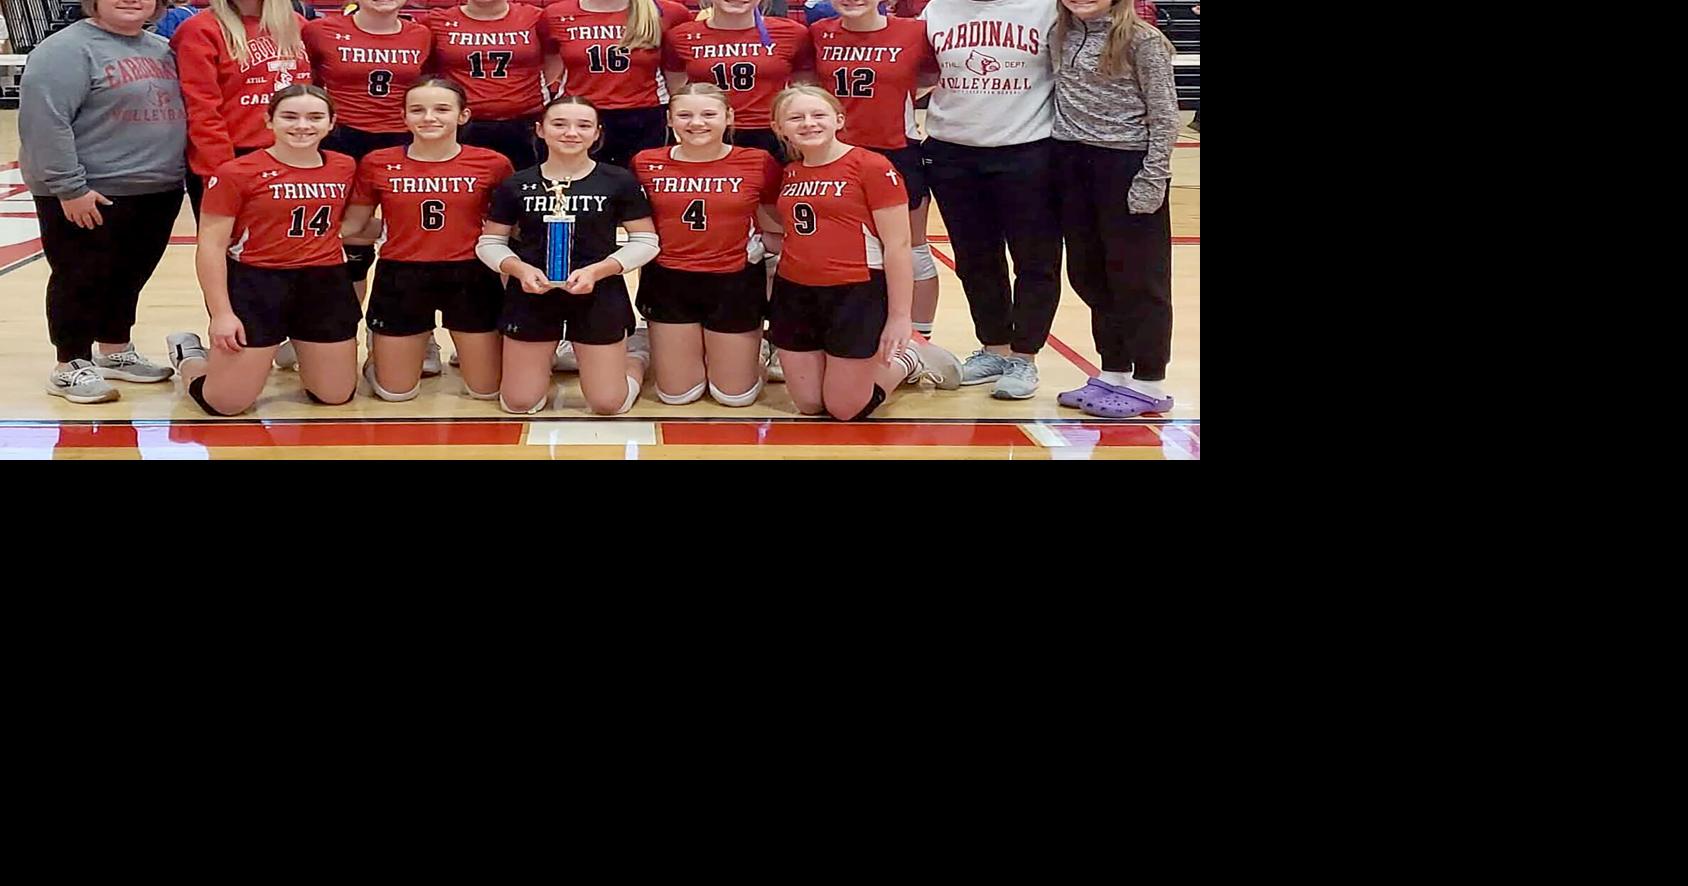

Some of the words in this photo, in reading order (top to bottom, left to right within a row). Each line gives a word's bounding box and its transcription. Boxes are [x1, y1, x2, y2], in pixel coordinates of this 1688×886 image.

[448, 31, 530, 46] TRINITY
[566, 25, 626, 41] TRINI
[931, 20, 1040, 55] CARDINALS
[337, 46, 421, 65] TRINITY
[586, 45, 631, 74] 16
[691, 43, 776, 59] TRINITY
[821, 46, 902, 63] TRINITY
[467, 51, 513, 79] 17
[367, 69, 393, 97] 8
[711, 62, 756, 92] 18
[834, 67, 876, 98] 12
[940, 77, 1033, 91] VOLLEYBALL
[268, 182, 347, 200] TRINITY
[388, 176, 478, 193] TRINITY
[652, 176, 744, 193] TRINITY
[782, 180, 848, 197] TRINITY
[287, 205, 332, 238] 14
[420, 199, 446, 232] 6
[681, 199, 707, 232] 4
[792, 202, 817, 236] 9
